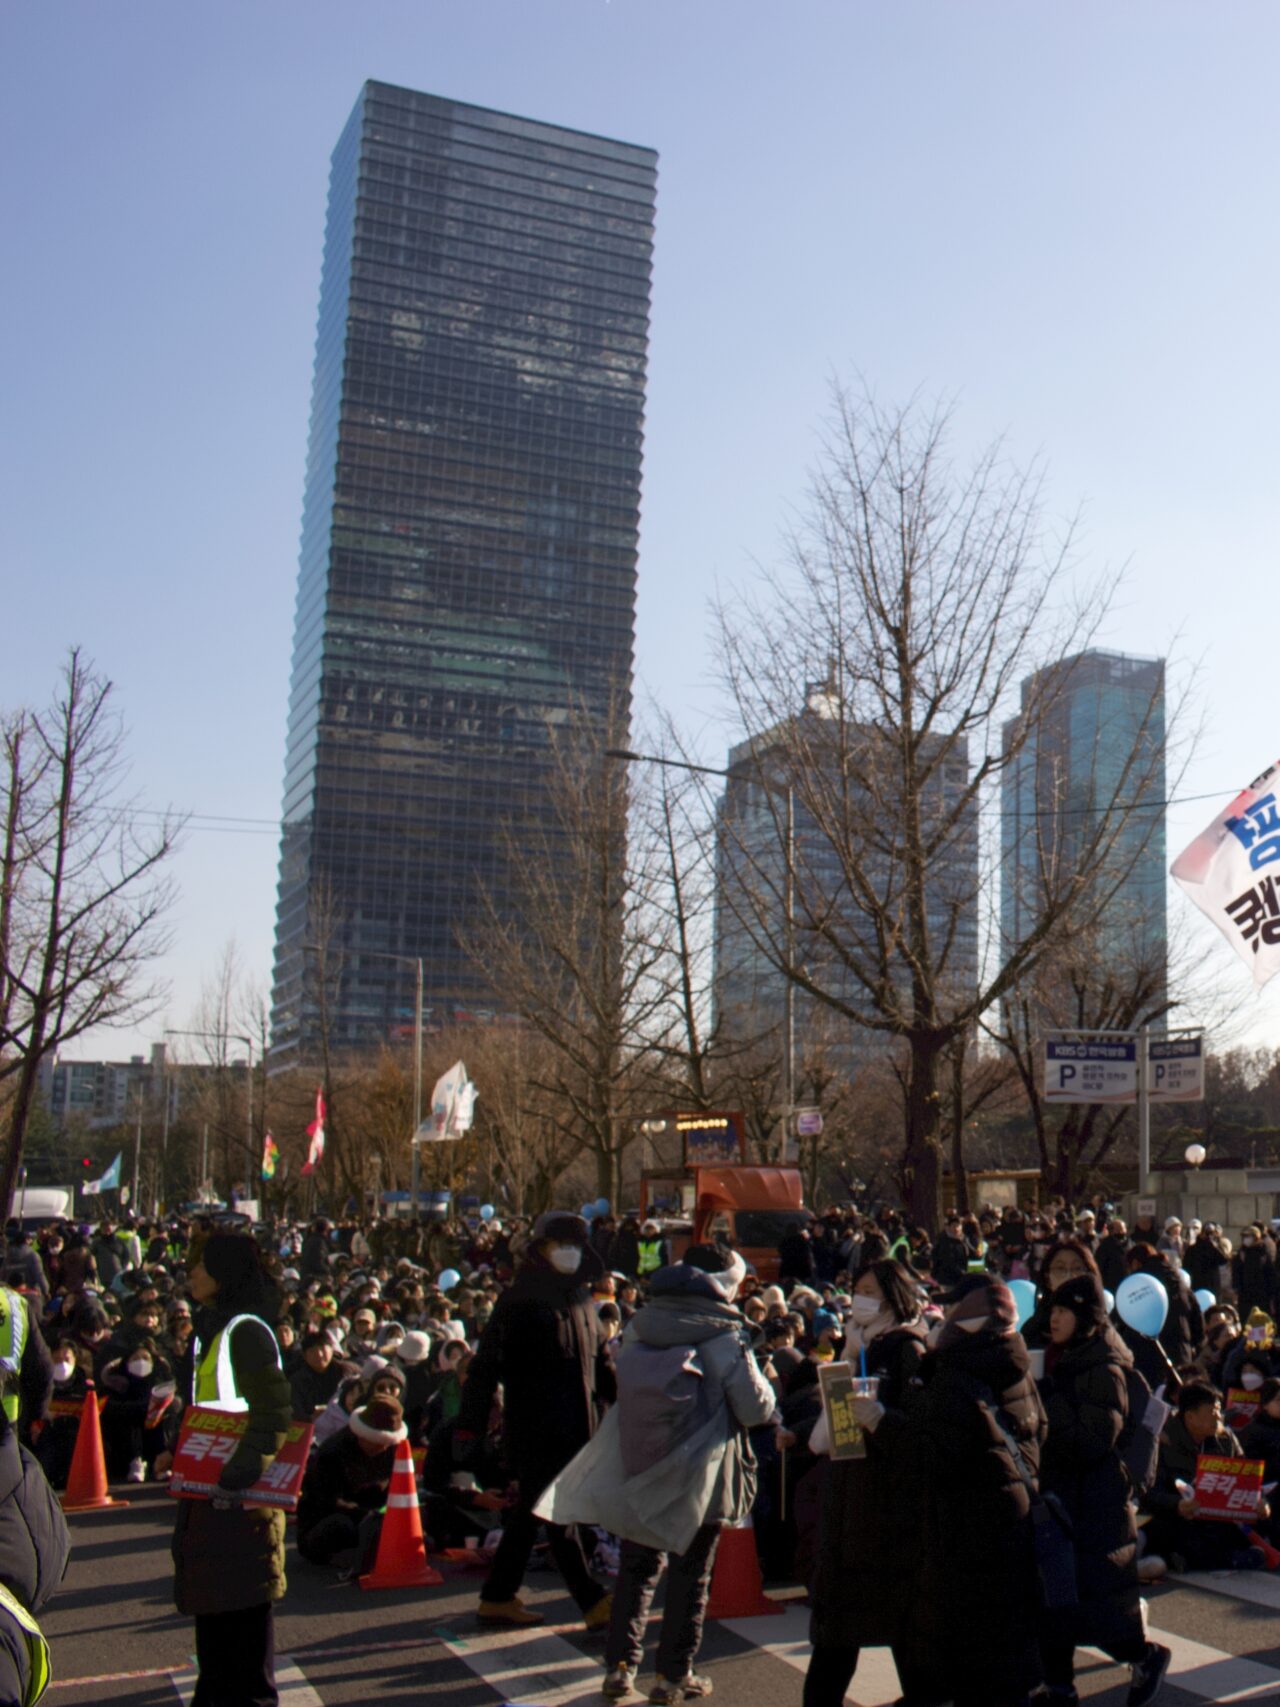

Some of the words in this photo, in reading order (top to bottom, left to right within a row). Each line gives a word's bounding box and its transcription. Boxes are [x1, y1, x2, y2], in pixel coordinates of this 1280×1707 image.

[1055, 1046, 1076, 1057] KBS
[1059, 1064, 1077, 1088] P
[1155, 1063, 1166, 1088] P
